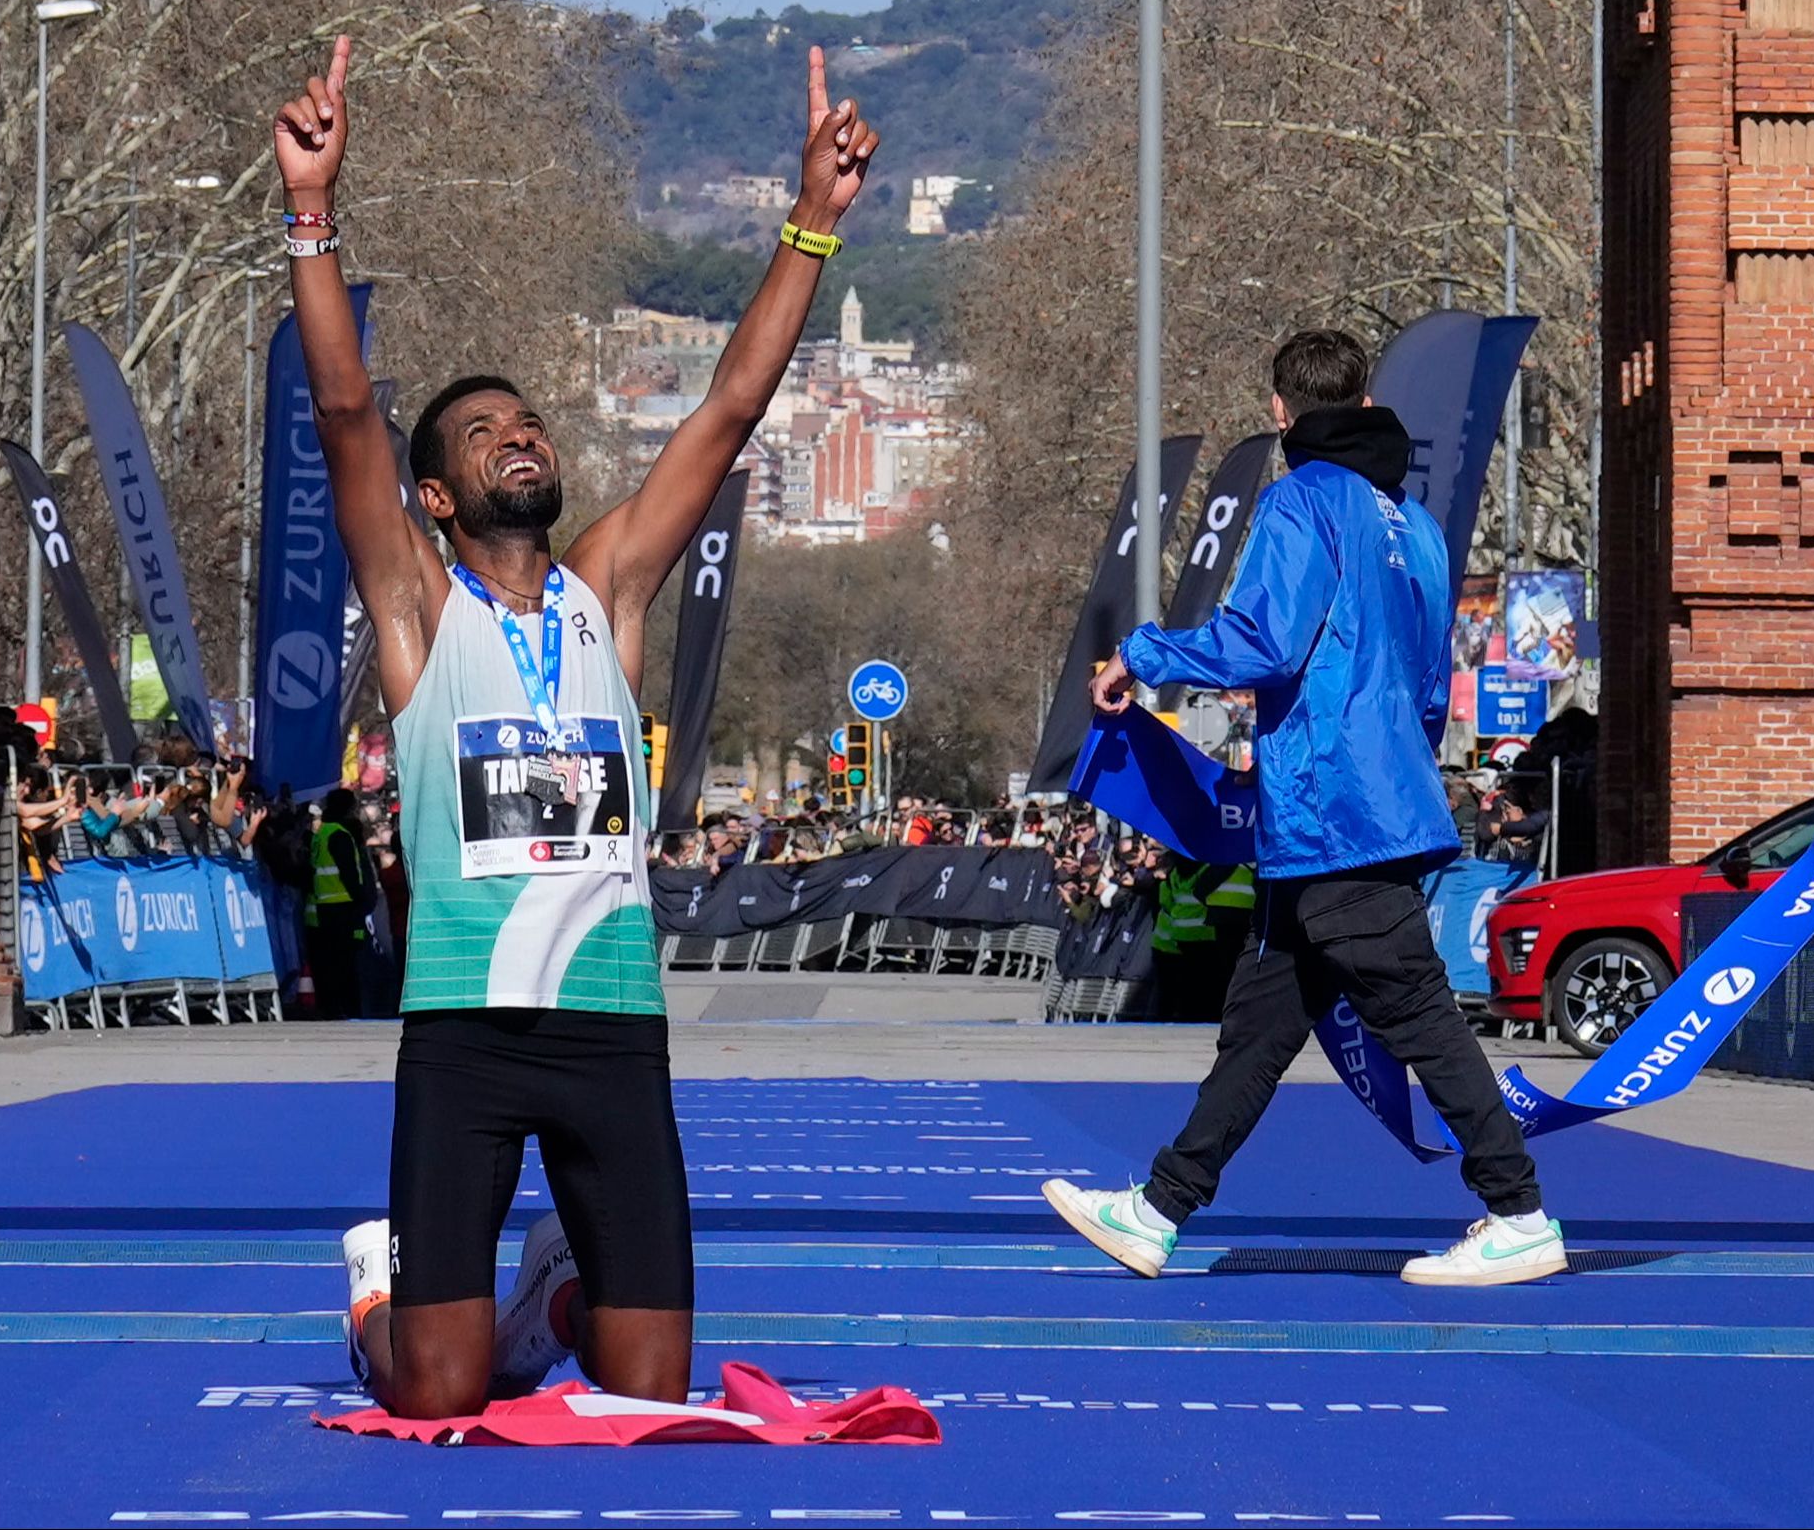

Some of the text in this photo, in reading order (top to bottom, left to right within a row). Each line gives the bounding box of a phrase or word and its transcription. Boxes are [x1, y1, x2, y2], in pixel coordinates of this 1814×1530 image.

[526, 729, 585, 744] ZUCH
[1497, 711, 1527, 726] taxi
[140, 892, 200, 932] ZURICH
[1604, 1009, 1711, 1108] ZURICH
[1496, 1072, 1538, 1112] URICH
